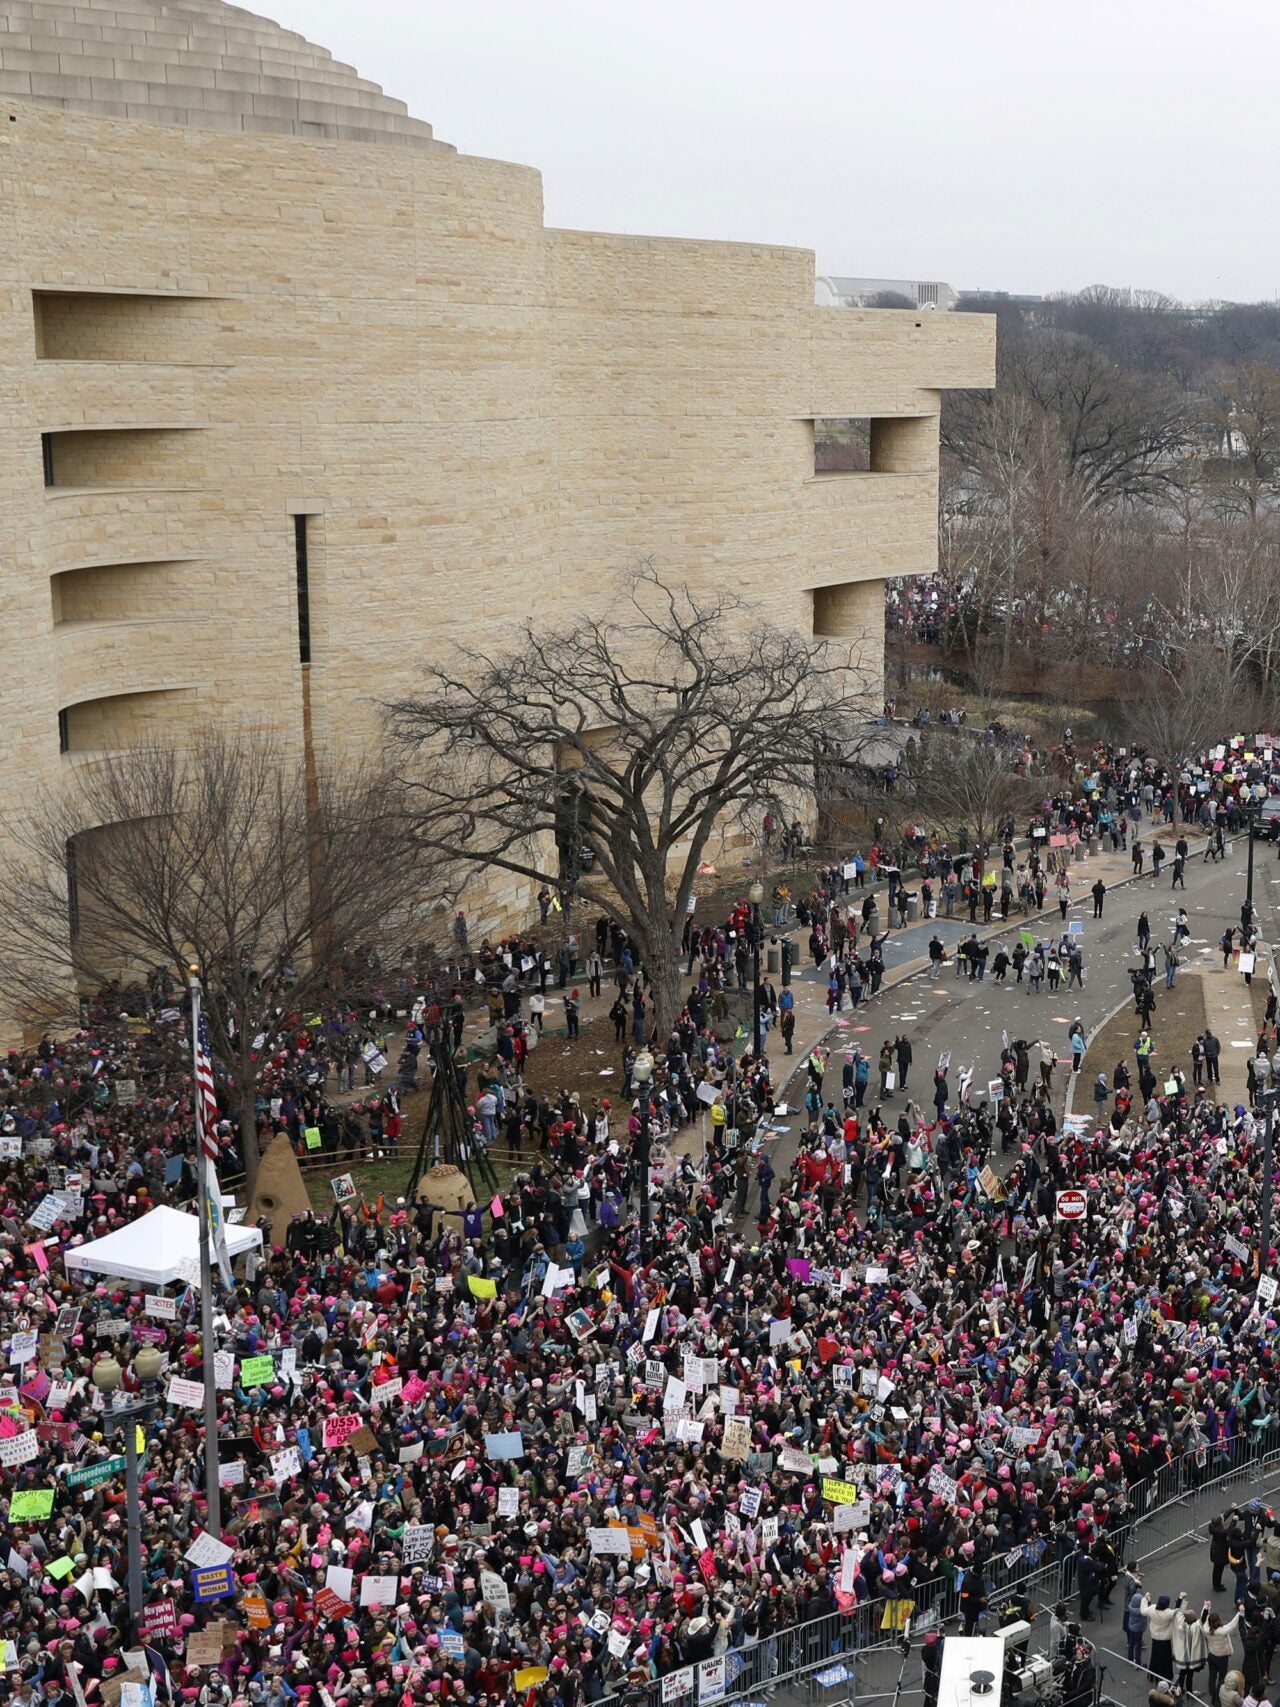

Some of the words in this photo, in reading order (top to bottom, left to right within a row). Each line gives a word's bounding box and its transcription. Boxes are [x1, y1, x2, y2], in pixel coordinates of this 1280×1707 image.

[650, 1362, 660, 1371] NO
[646, 1370, 662, 1381] GOING
[326, 1416, 359, 1429] PUSSY
[326, 1427, 351, 1438] GRABS
[70, 1463, 112, 1484] Independence
[90, 1476, 103, 1486] 300
[405, 1528, 420, 1537] GET
[403, 1548, 432, 1564] PUSSY
[200, 1572, 224, 1581] NASTY
[200, 1584, 226, 1594] WOMAN
[144, 1606, 154, 1616] Now
[154, 1602, 172, 1616] you've
[164, 1614, 174, 1623] the
[702, 1658, 723, 1671] HANDS
